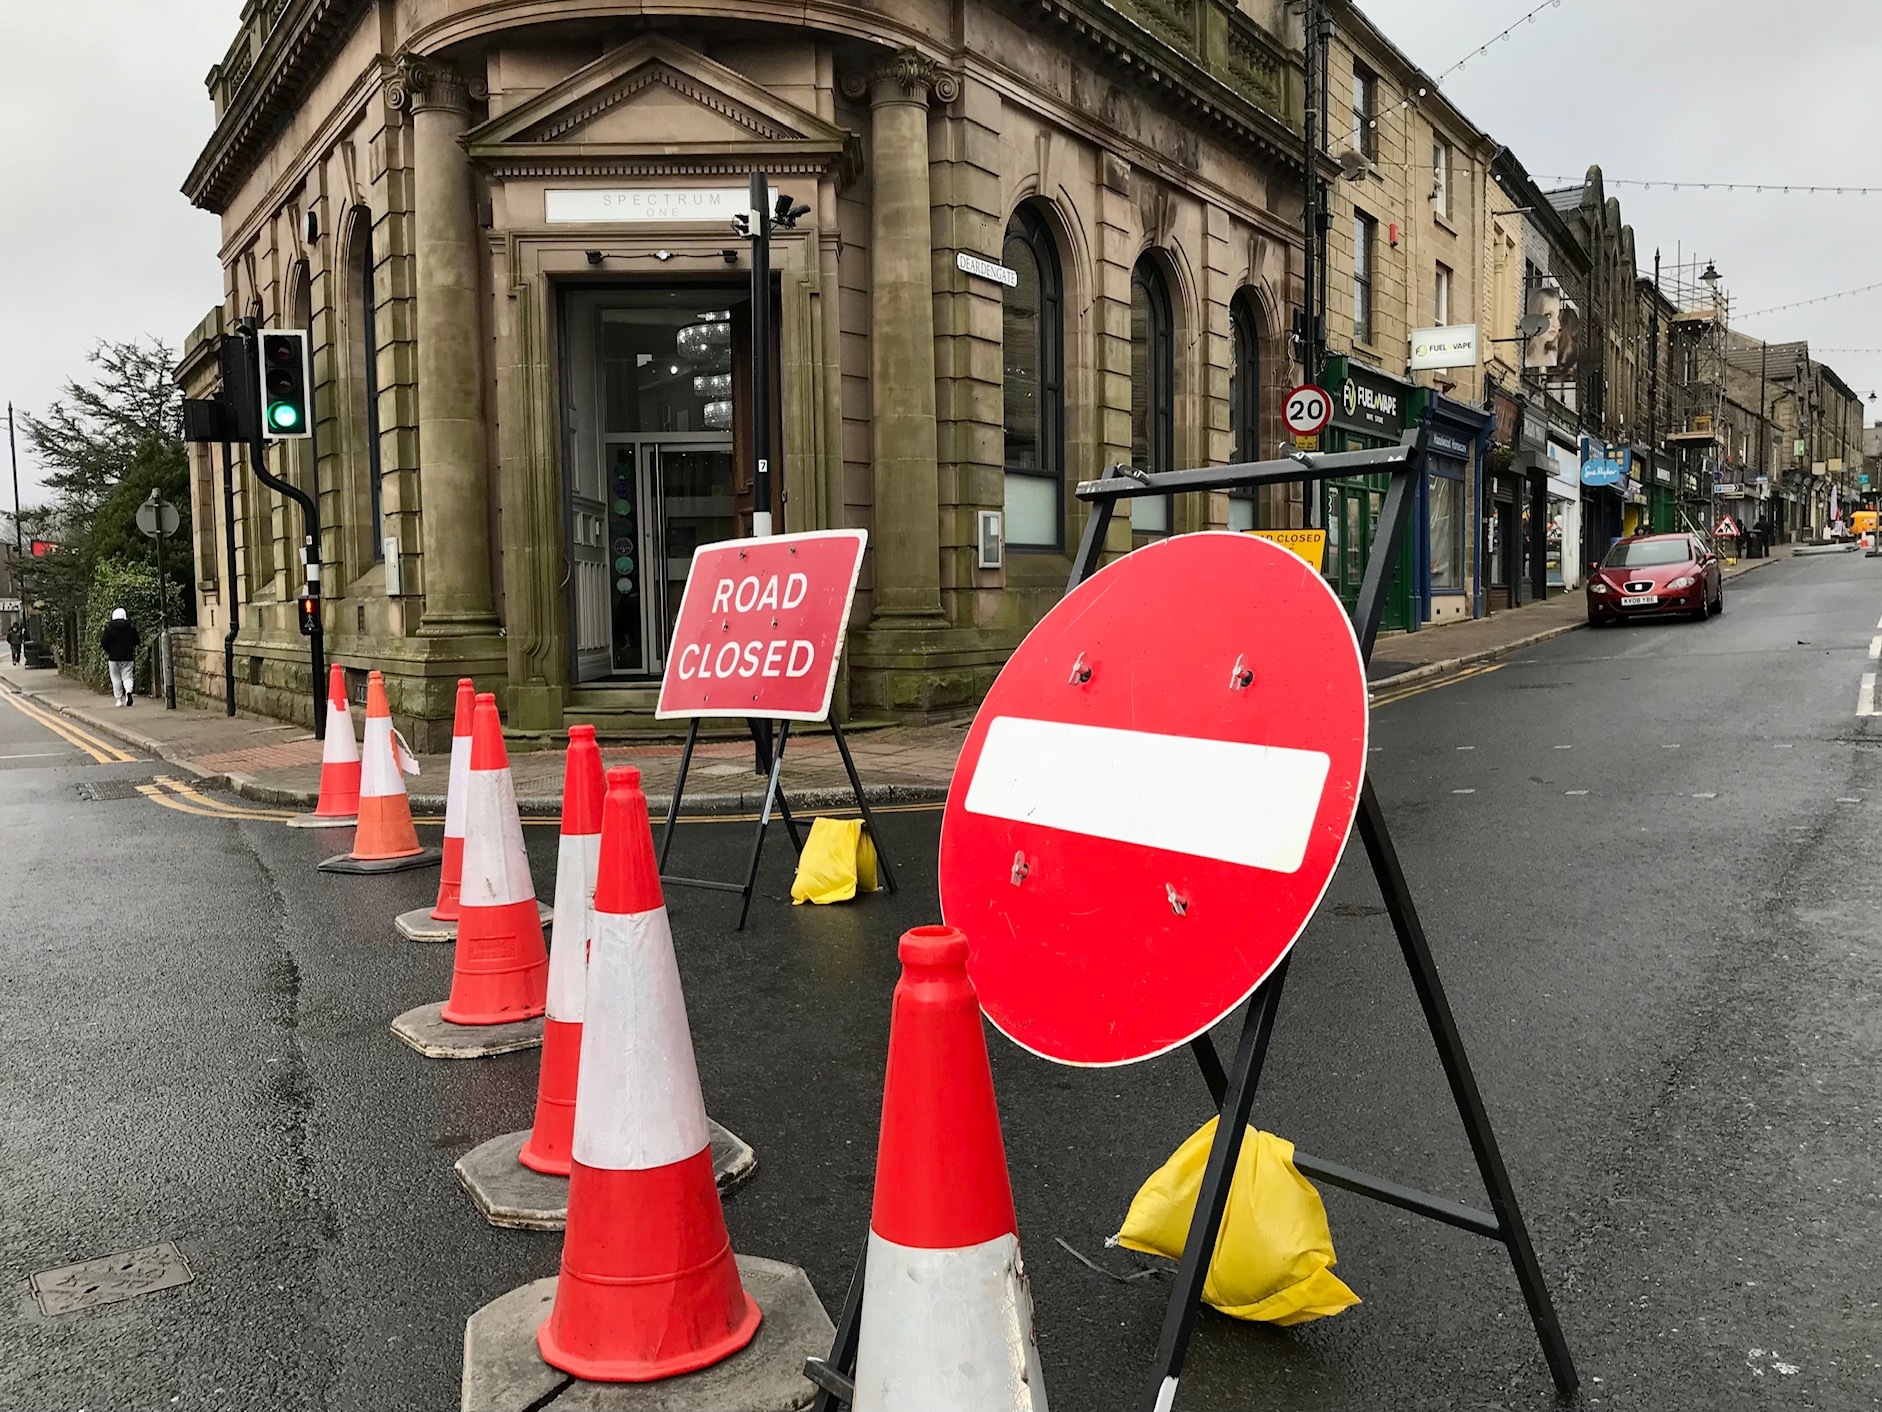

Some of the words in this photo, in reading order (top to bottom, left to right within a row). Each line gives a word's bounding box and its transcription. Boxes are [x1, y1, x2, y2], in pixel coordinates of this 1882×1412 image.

[603, 193, 721, 206] SPECTRUM
[646, 208, 679, 217] ONE
[960, 255, 1016, 284] DEARDENGATE
[1290, 399, 1323, 420] 20
[760, 461, 766, 470] 7
[1277, 534, 1321, 543] CLOSED
[712, 573, 808, 614] ROAD
[678, 640, 815, 680] CLOSED
